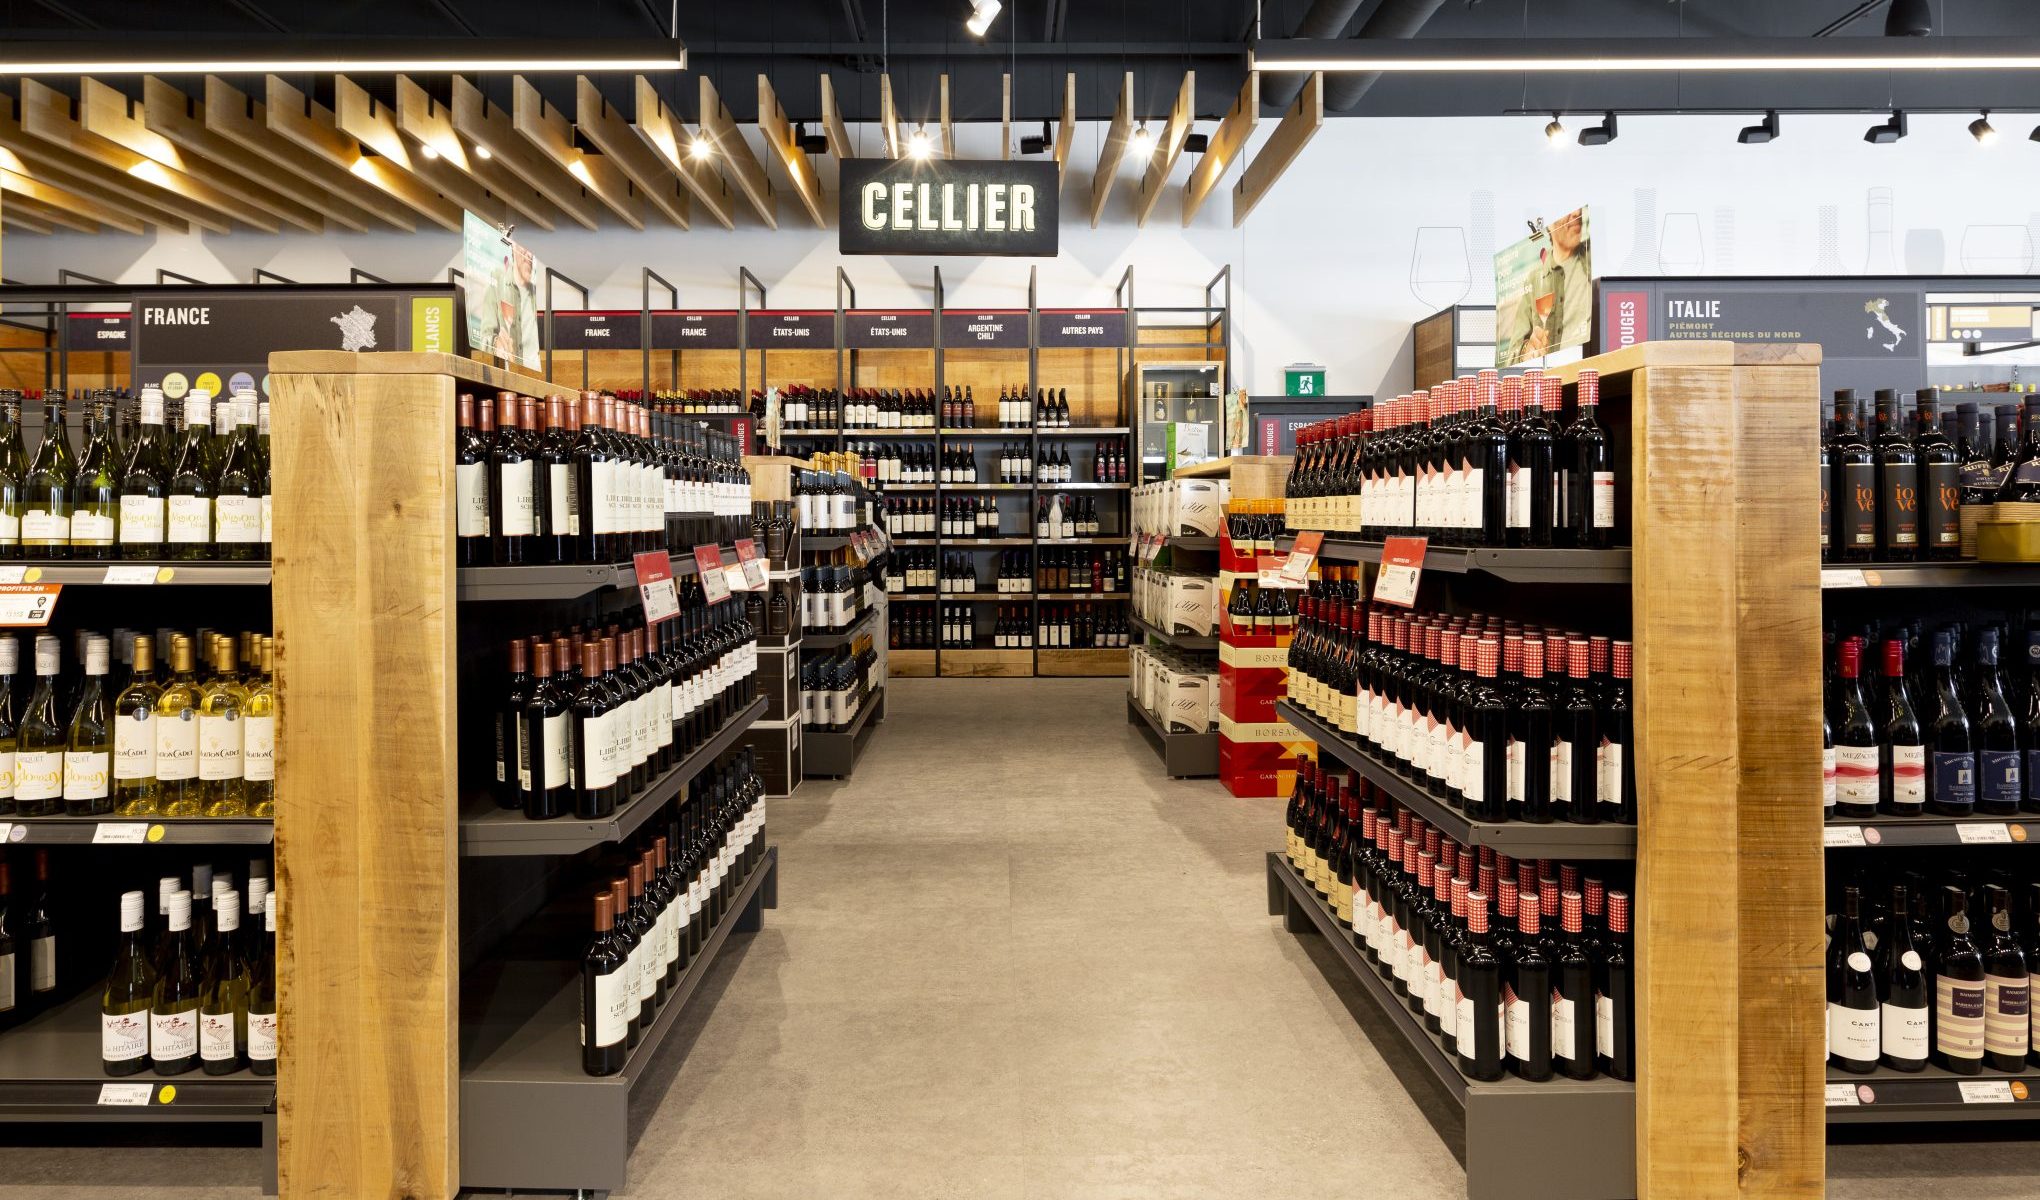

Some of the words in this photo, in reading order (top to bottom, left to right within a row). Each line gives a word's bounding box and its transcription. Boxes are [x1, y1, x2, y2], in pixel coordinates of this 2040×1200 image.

[862, 182, 1035, 231] CELLIER
[1668, 300, 1720, 318] ITALIE
[144, 307, 209, 325] FRANCE
[870, 326, 907, 336] ÉTATS-UNIS
[968, 324, 1003, 332] ARGENTINE
[1062, 327, 1086, 335] AUTRES
[1088, 327, 1103, 335] PAYS
[1669, 321, 1714, 330] PIÉMONT
[97, 331, 126, 339] ESPAGNE
[585, 329, 610, 337] FRANCE
[682, 328, 707, 336] FRANCE
[773, 327, 810, 336] ÉTATS-UNIS
[1669, 331, 1708, 339] AUTRES
[1711, 330, 1754, 339] RÉGIONS
[1757, 331, 1771, 339] DU
[1774, 331, 1801, 339] NORD
[1266, 424, 1274, 447] ROUGES
[1856, 484, 1873, 500] io
[1895, 483, 1914, 500] io
[1940, 483, 1960, 500] io
[1856, 500, 1874, 512] ve
[1895, 500, 1916, 512] ve
[1941, 500, 1960, 511] ve
[1255, 655, 1287, 663] BORS
[112, 1041, 144, 1052] HITAIRE
[162, 1041, 193, 1052] HITAIRE
